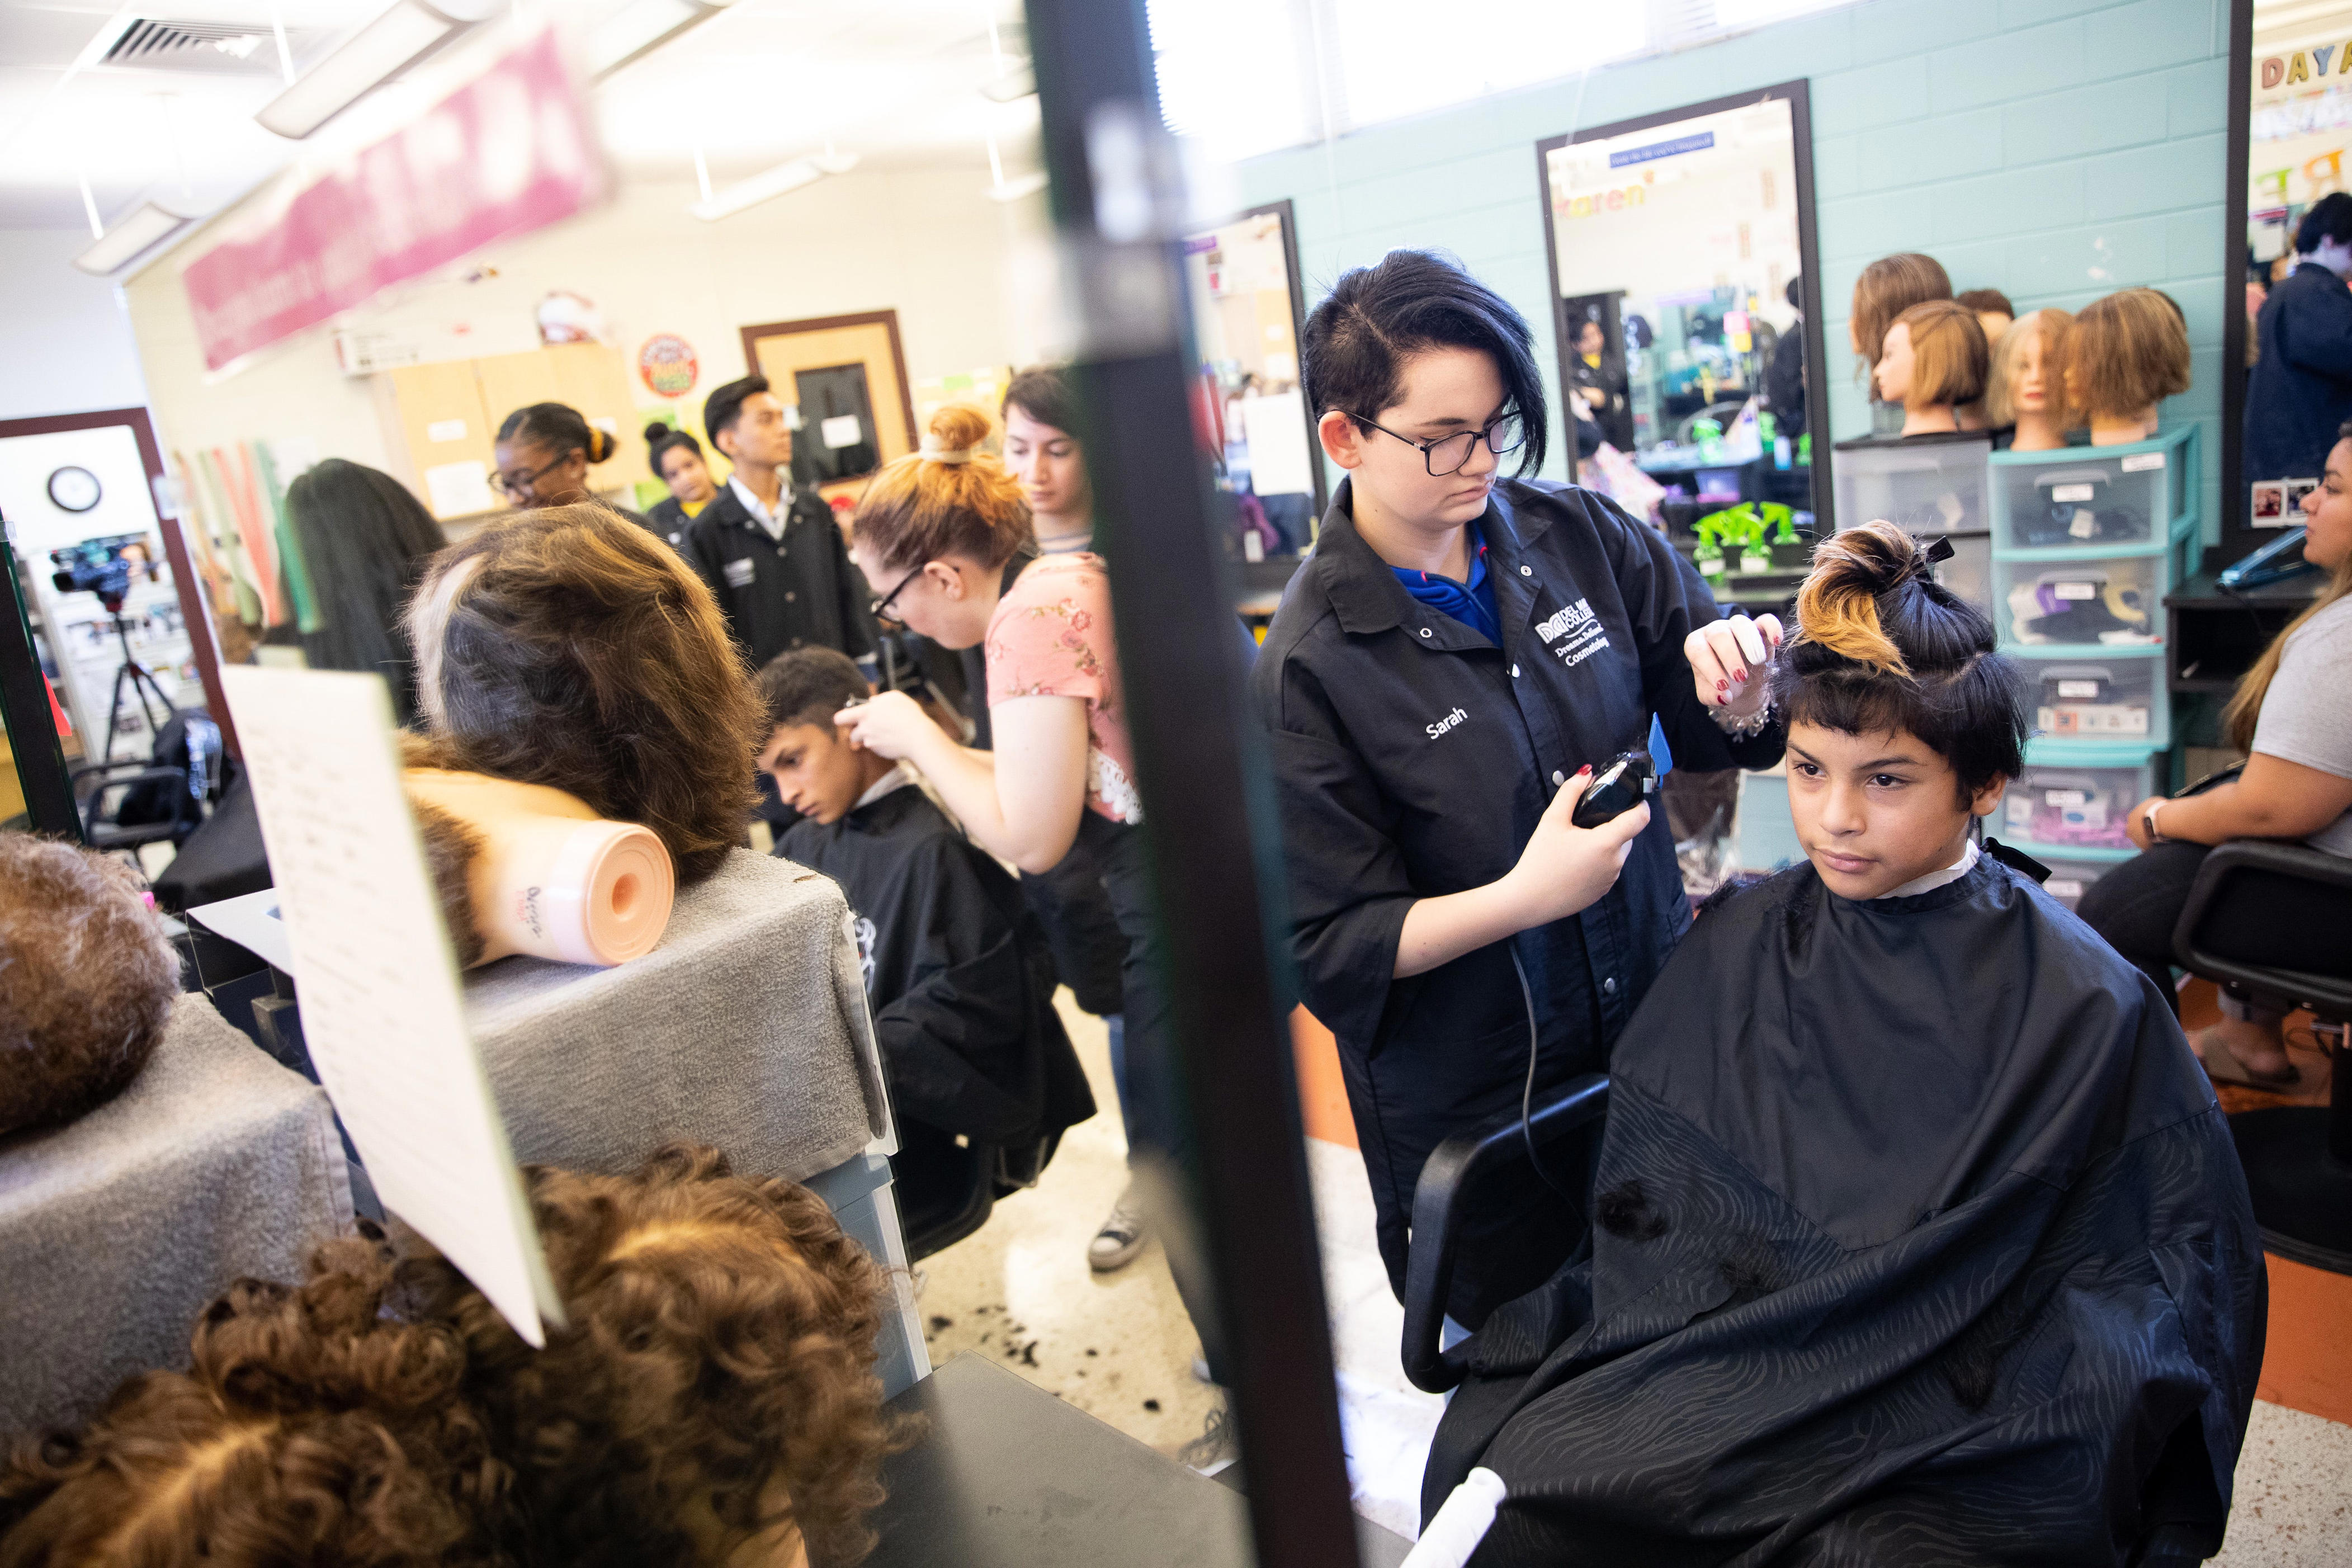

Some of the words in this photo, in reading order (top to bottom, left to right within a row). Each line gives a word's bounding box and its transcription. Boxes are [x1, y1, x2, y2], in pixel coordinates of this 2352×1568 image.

[1558, 604, 1579, 621] DEL
[1575, 597, 1589, 612] MA
[1425, 707, 1468, 740] Sarah
